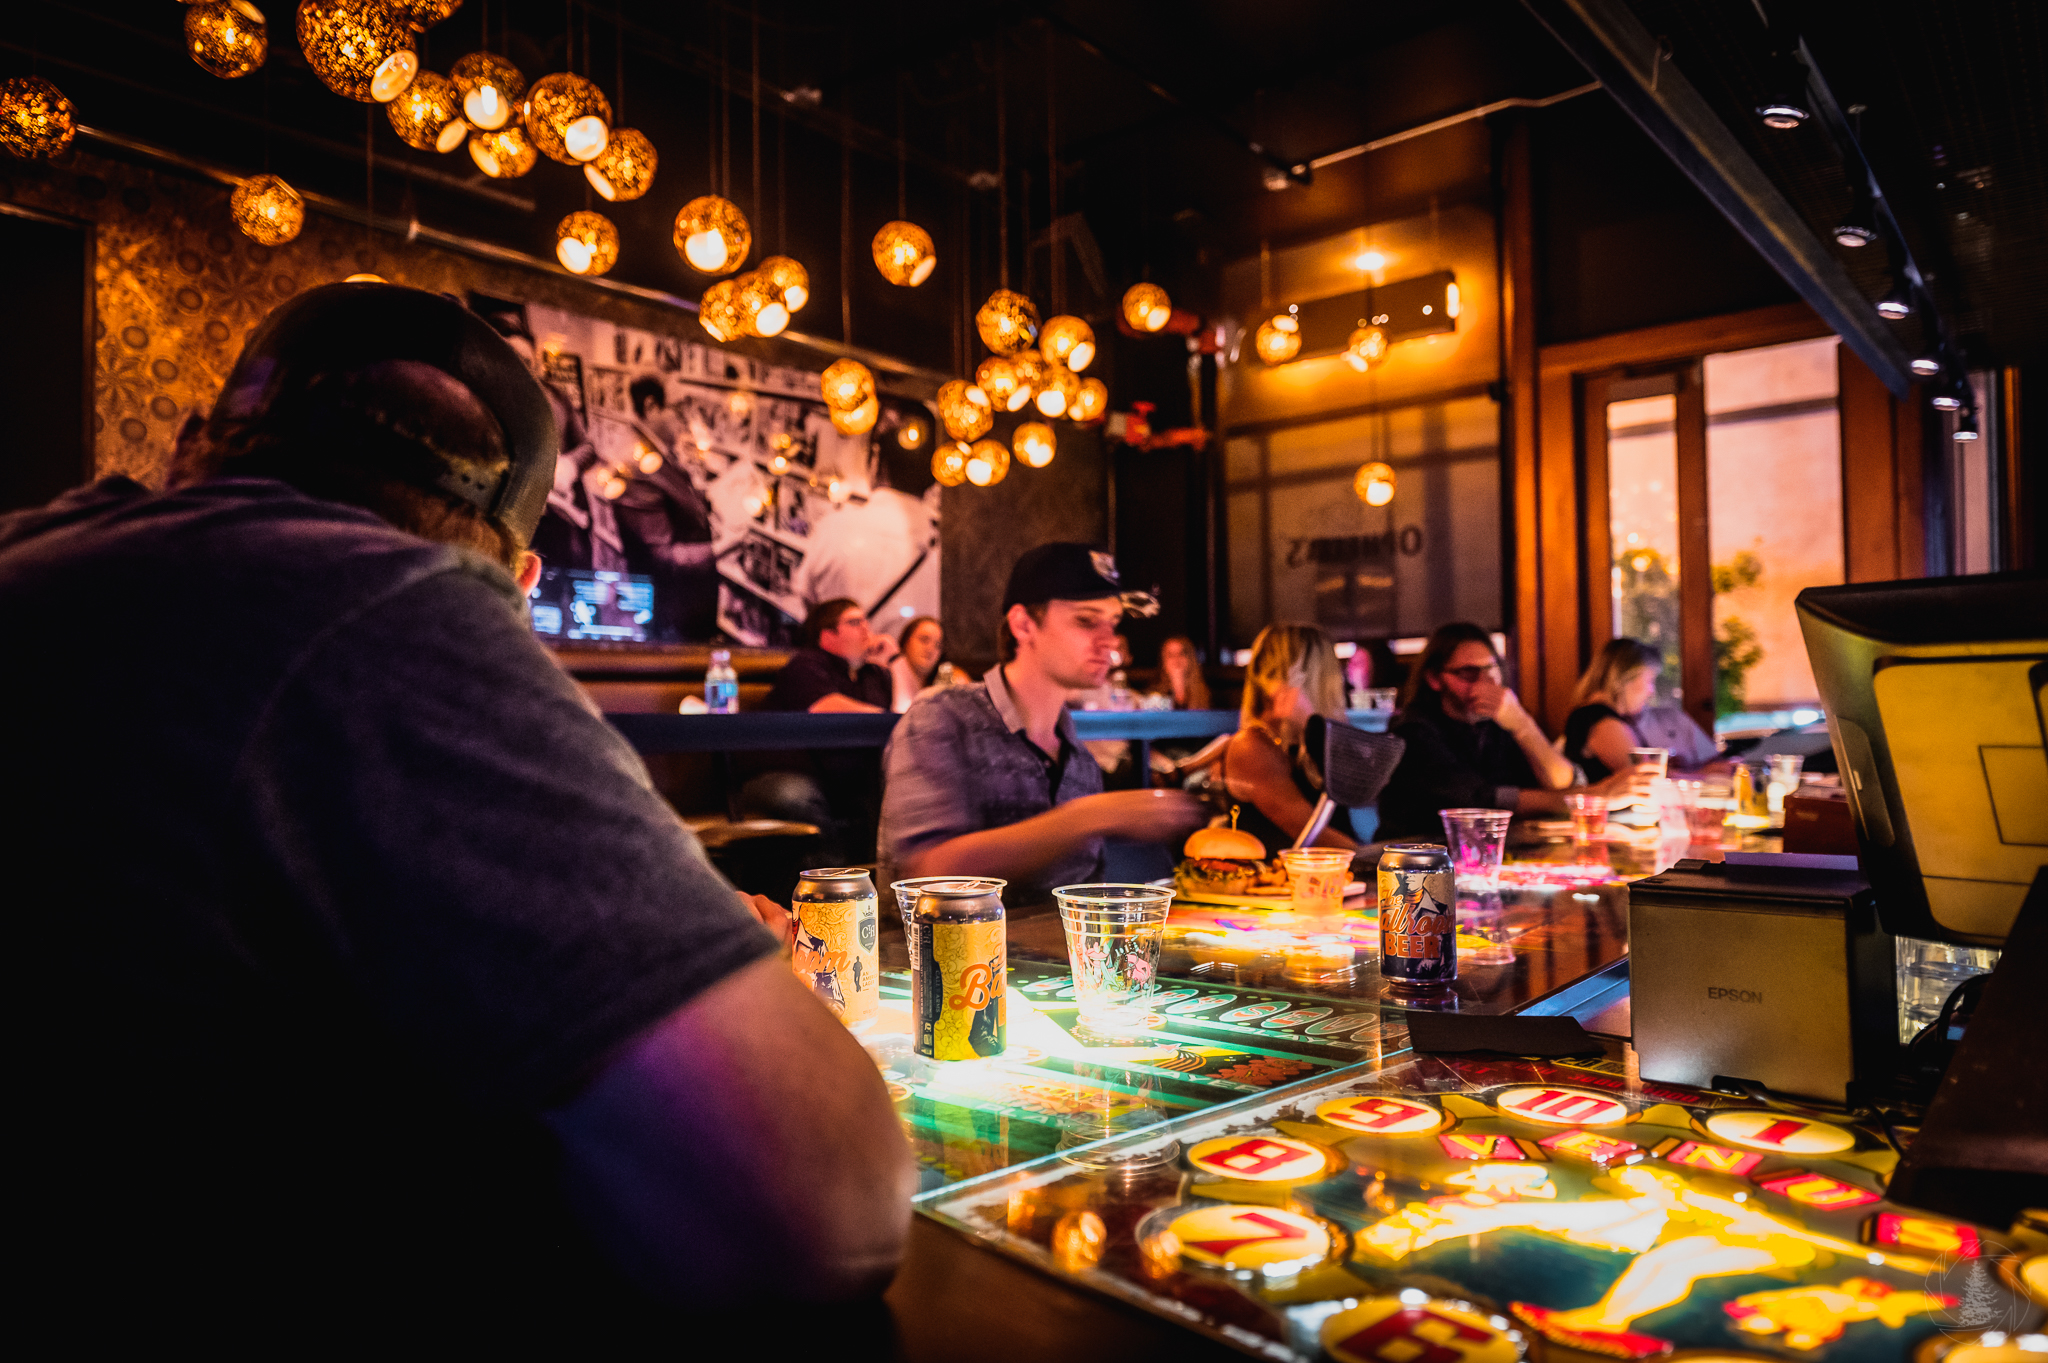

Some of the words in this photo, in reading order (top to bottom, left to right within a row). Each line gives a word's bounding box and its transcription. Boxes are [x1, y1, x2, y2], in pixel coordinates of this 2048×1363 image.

[1384, 933, 1440, 959] BEER
[1708, 987, 1762, 1004] EPSON
[1325, 1098, 1429, 1129] 9
[1507, 1090, 1618, 1122] 10
[1743, 1118, 1808, 1146] 1
[1199, 1139, 1312, 1175] 8
[1184, 1212, 1308, 1257] 7
